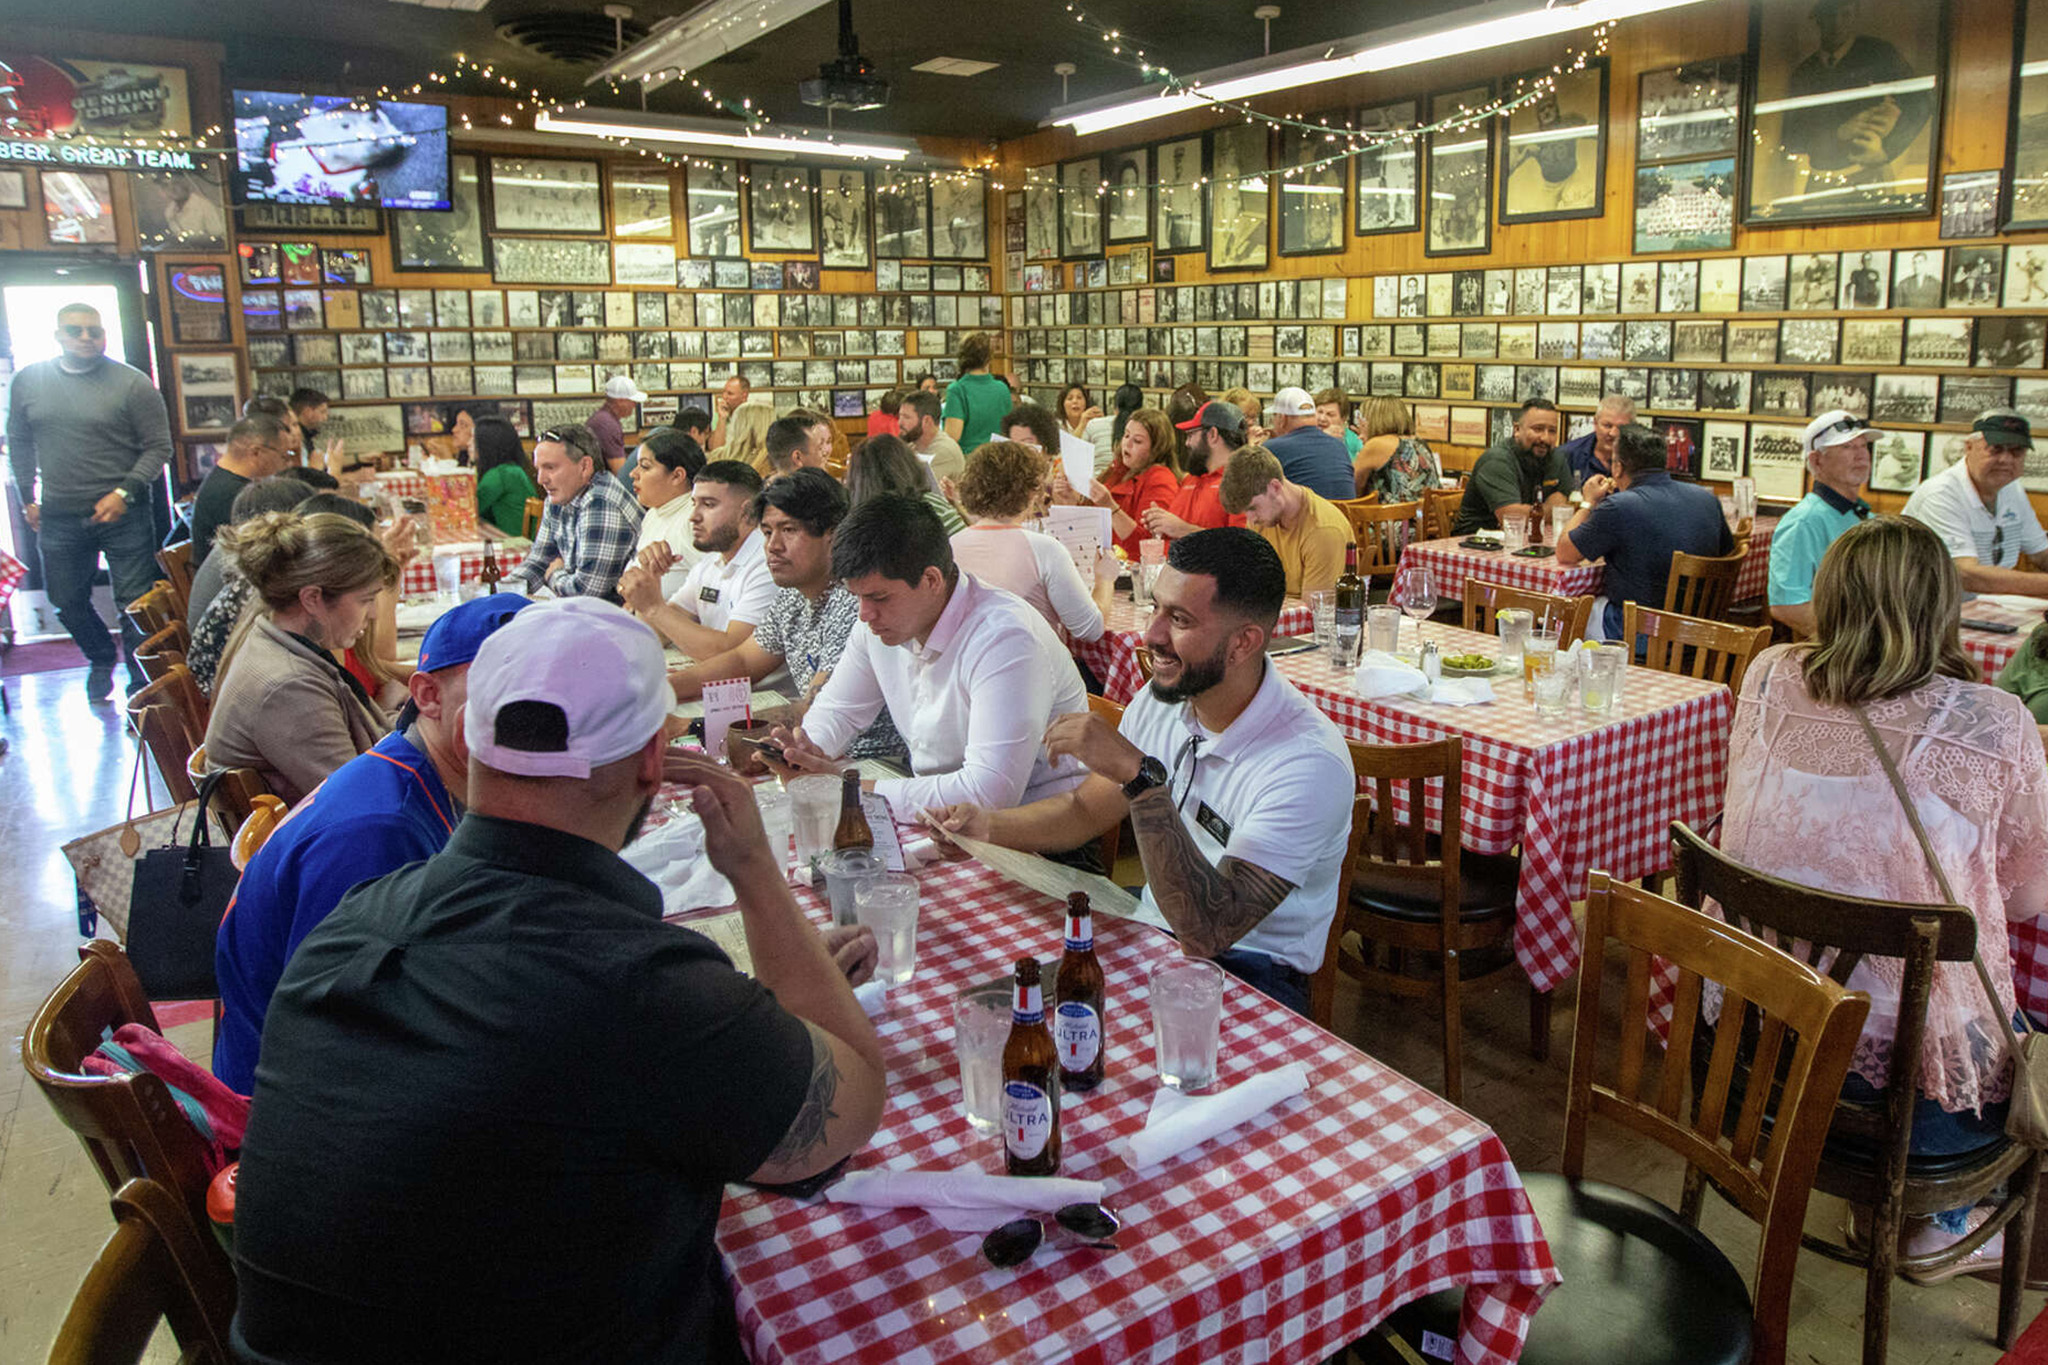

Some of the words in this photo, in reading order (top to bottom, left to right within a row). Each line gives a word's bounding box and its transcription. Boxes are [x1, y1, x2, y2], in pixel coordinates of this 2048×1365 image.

[86, 101, 157, 119] DRAFT
[61, 145, 129, 167] GREAT
[133, 149, 196, 170] TEAM.
